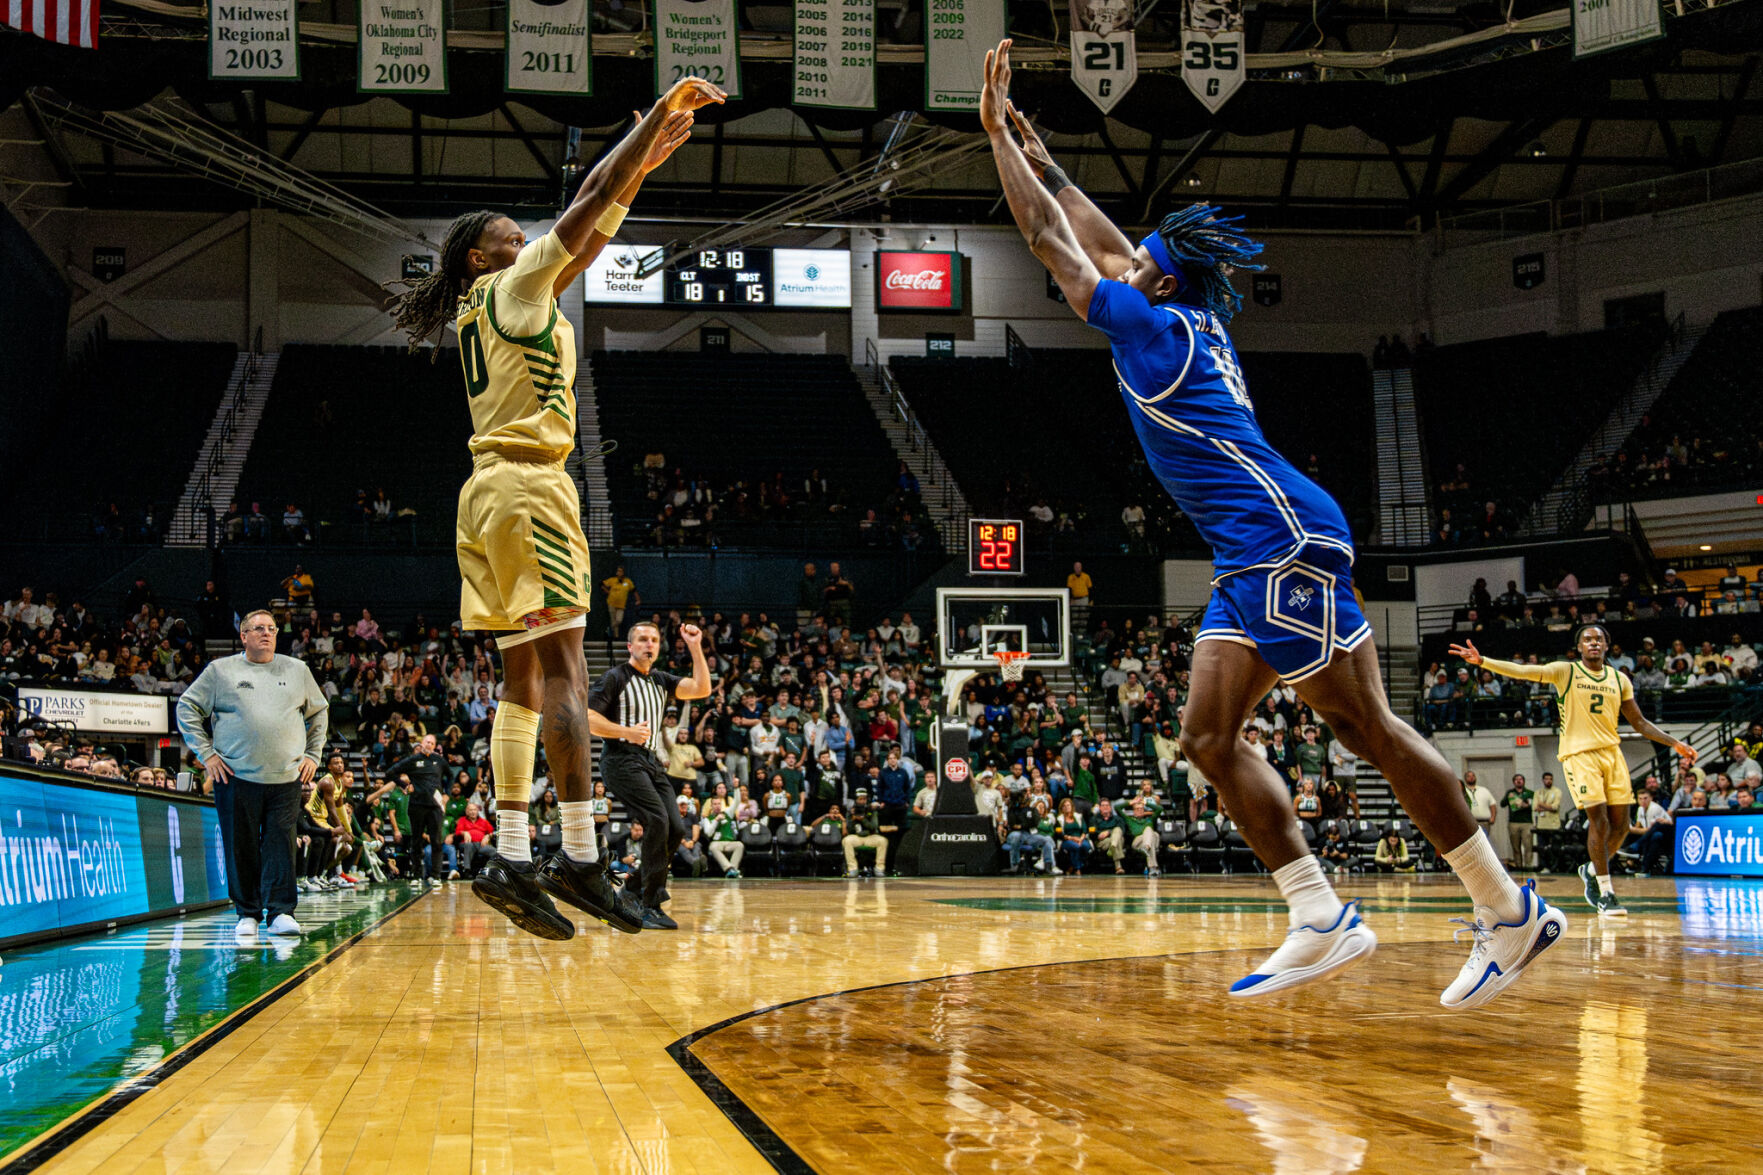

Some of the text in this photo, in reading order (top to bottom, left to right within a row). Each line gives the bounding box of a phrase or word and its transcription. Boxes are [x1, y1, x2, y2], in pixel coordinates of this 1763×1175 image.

[218, 6, 289, 21] Midwest
[381, 6, 424, 20] Women's
[669, 13, 722, 25] Women's
[797, 10, 828, 20] 2005
[842, 12, 872, 22] 2014
[933, 13, 964, 24] 2009
[218, 26, 291, 44] Regional
[366, 23, 438, 41] Oklahoma City
[511, 20, 587, 37] Semifinalist
[665, 27, 727, 42] Bridgeport
[797, 26, 828, 36] 2006
[842, 27, 872, 37] 2016
[934, 29, 964, 39] 2022
[381, 42, 423, 59] Regional
[671, 43, 722, 57] Regional
[797, 41, 828, 51] 2007
[841, 42, 872, 51] 2019
[225, 48, 284, 69] 2003
[521, 51, 576, 73] 2011
[797, 56, 828, 67] 2008
[841, 57, 872, 67] 2021
[1084, 42, 1124, 70] 21
[1185, 41, 1239, 70] 35
[374, 63, 431, 84] 2009
[671, 65, 724, 85] 2022
[797, 72, 828, 82] 2010
[797, 87, 827, 97] 2011
[934, 94, 982, 105] Champi
[605, 281, 644, 292] Teeter
[684, 283, 703, 301] 18
[746, 284, 765, 302] 15
[780, 283, 814, 293] Atrium
[929, 340, 952, 350] 212
[460, 318, 490, 399] 0
[979, 541, 1011, 569] 22
[1576, 682, 1617, 695] CHARLOTTE
[45, 696, 85, 709] PARKS
[89, 698, 111, 706] Official
[1590, 693, 1604, 714] 2
[103, 717, 151, 726] Charlotte 49ers
[947, 765, 966, 773] CPI
[61, 812, 127, 898] Health
